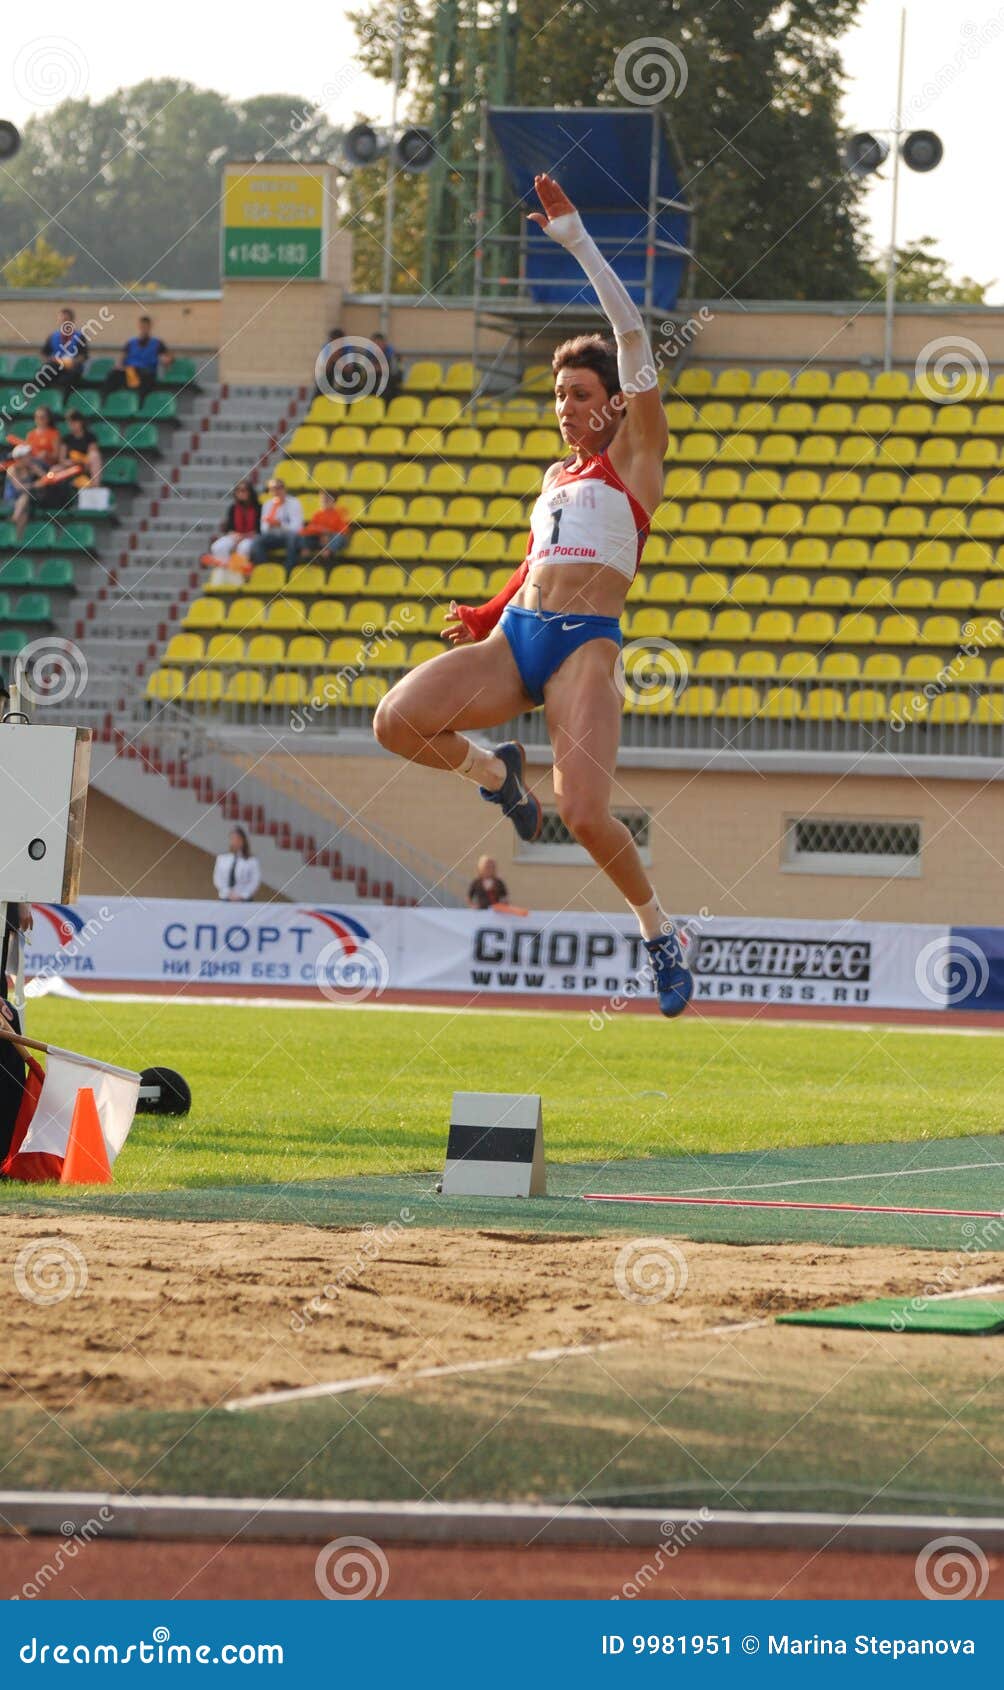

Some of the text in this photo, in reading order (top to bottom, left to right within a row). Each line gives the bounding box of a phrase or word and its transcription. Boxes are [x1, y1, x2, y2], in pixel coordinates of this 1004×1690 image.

[551, 508, 562, 544] 1
[163, 923, 313, 953] СПОРТ
[474, 927, 870, 980] СПОРТ ЭКСПРЕСС
[163, 960, 190, 975] НИ
[199, 961, 242, 977] ДНЯ
[251, 962, 291, 978] БЕЗ
